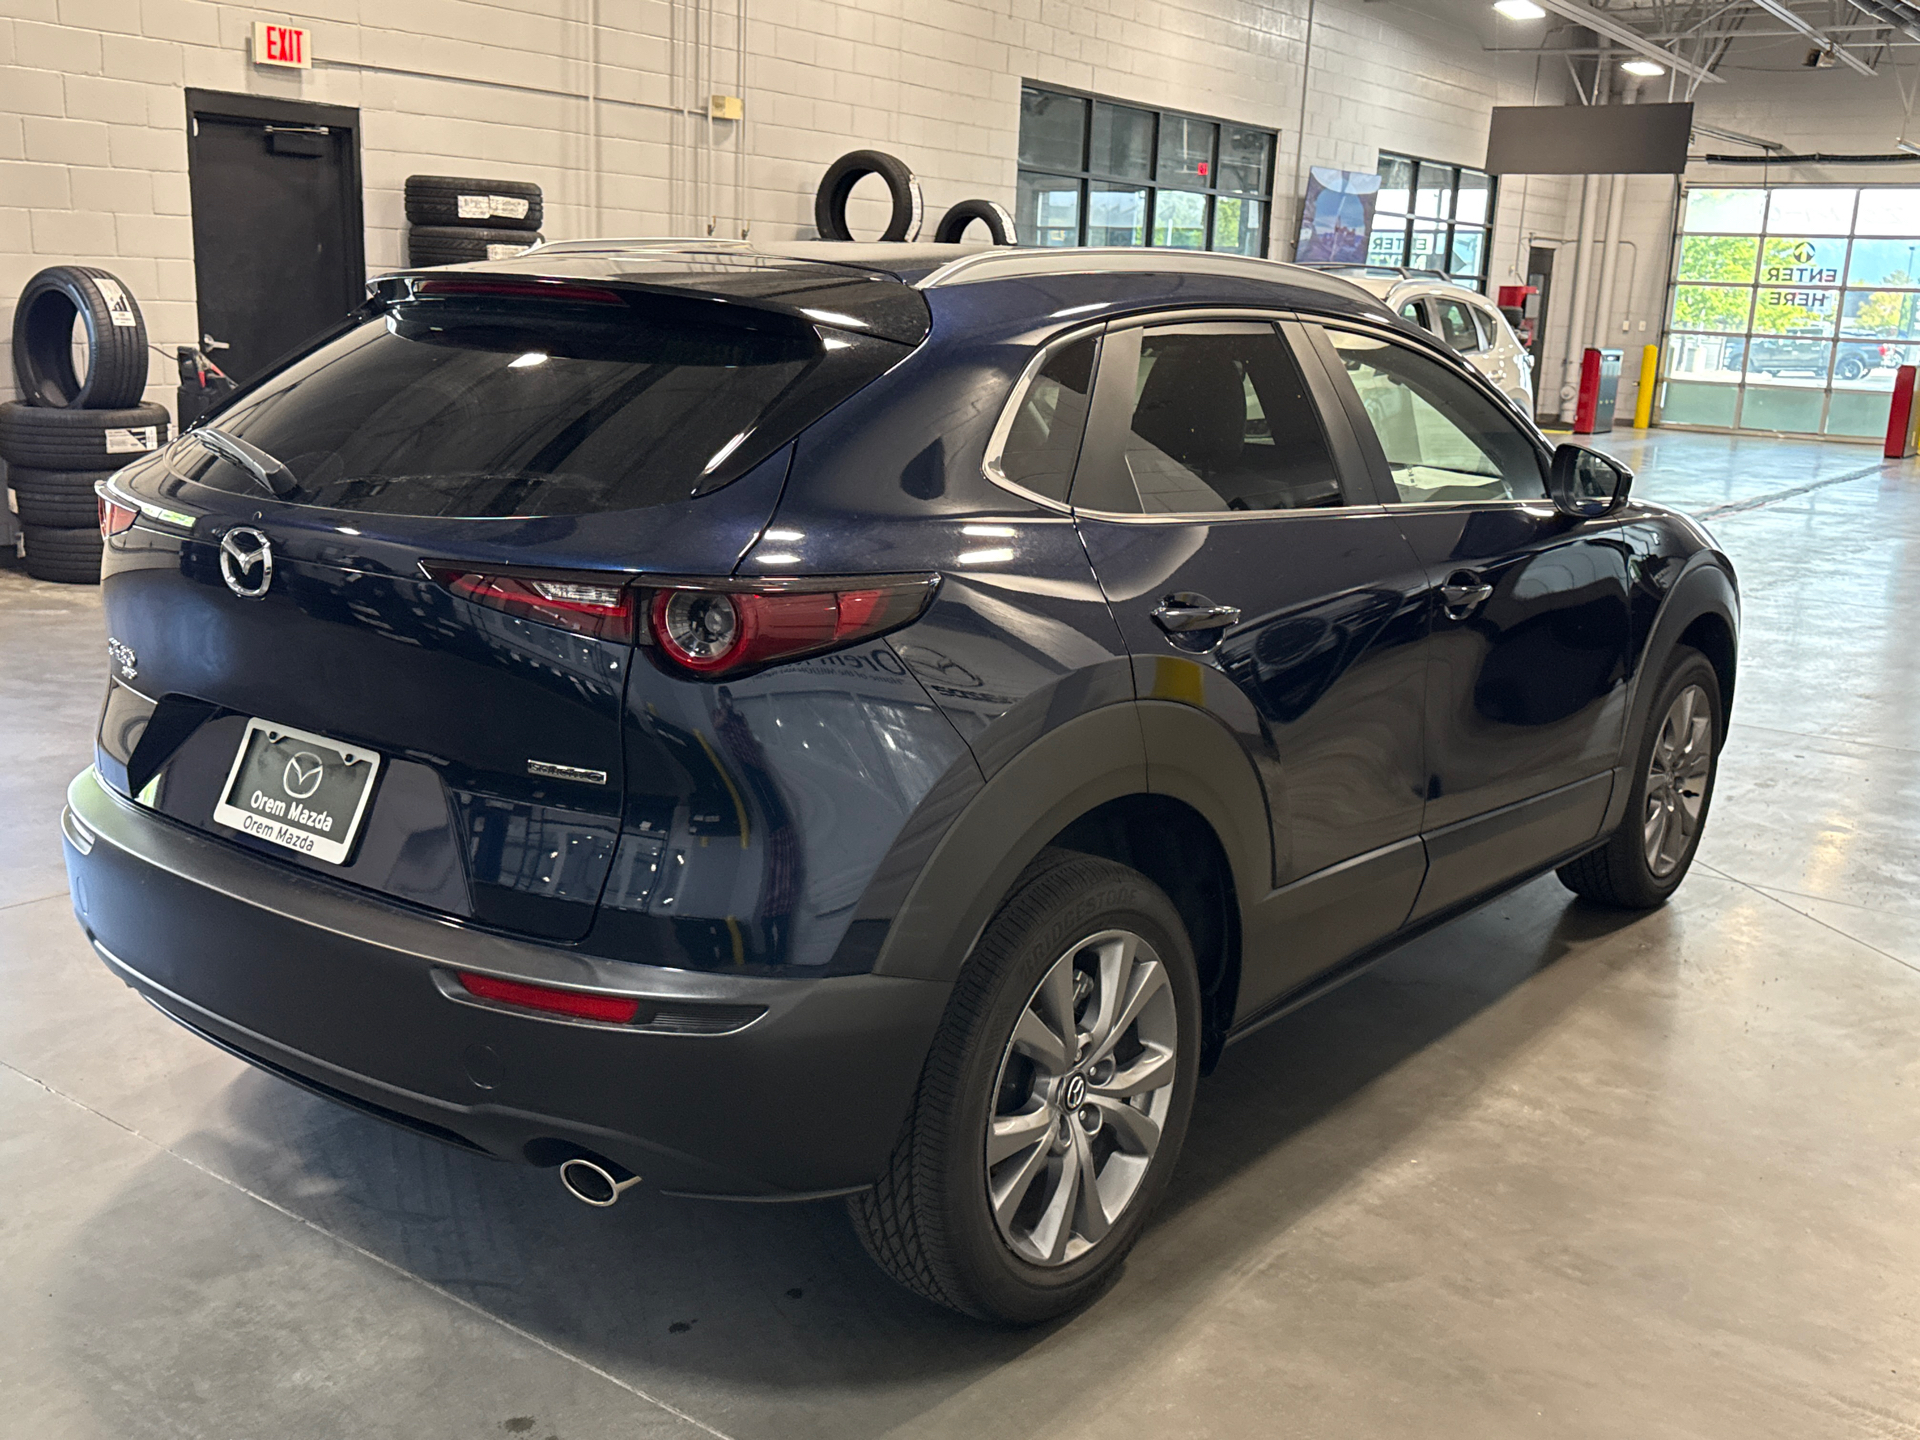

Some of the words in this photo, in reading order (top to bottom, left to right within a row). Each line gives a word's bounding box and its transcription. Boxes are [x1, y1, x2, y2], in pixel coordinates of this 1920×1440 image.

[266, 25, 303, 64] EXIT
[250, 790, 286, 818] Orem
[287, 802, 333, 832] Mazda
[243, 816, 274, 838] Orem
[275, 826, 315, 852] Mazda
